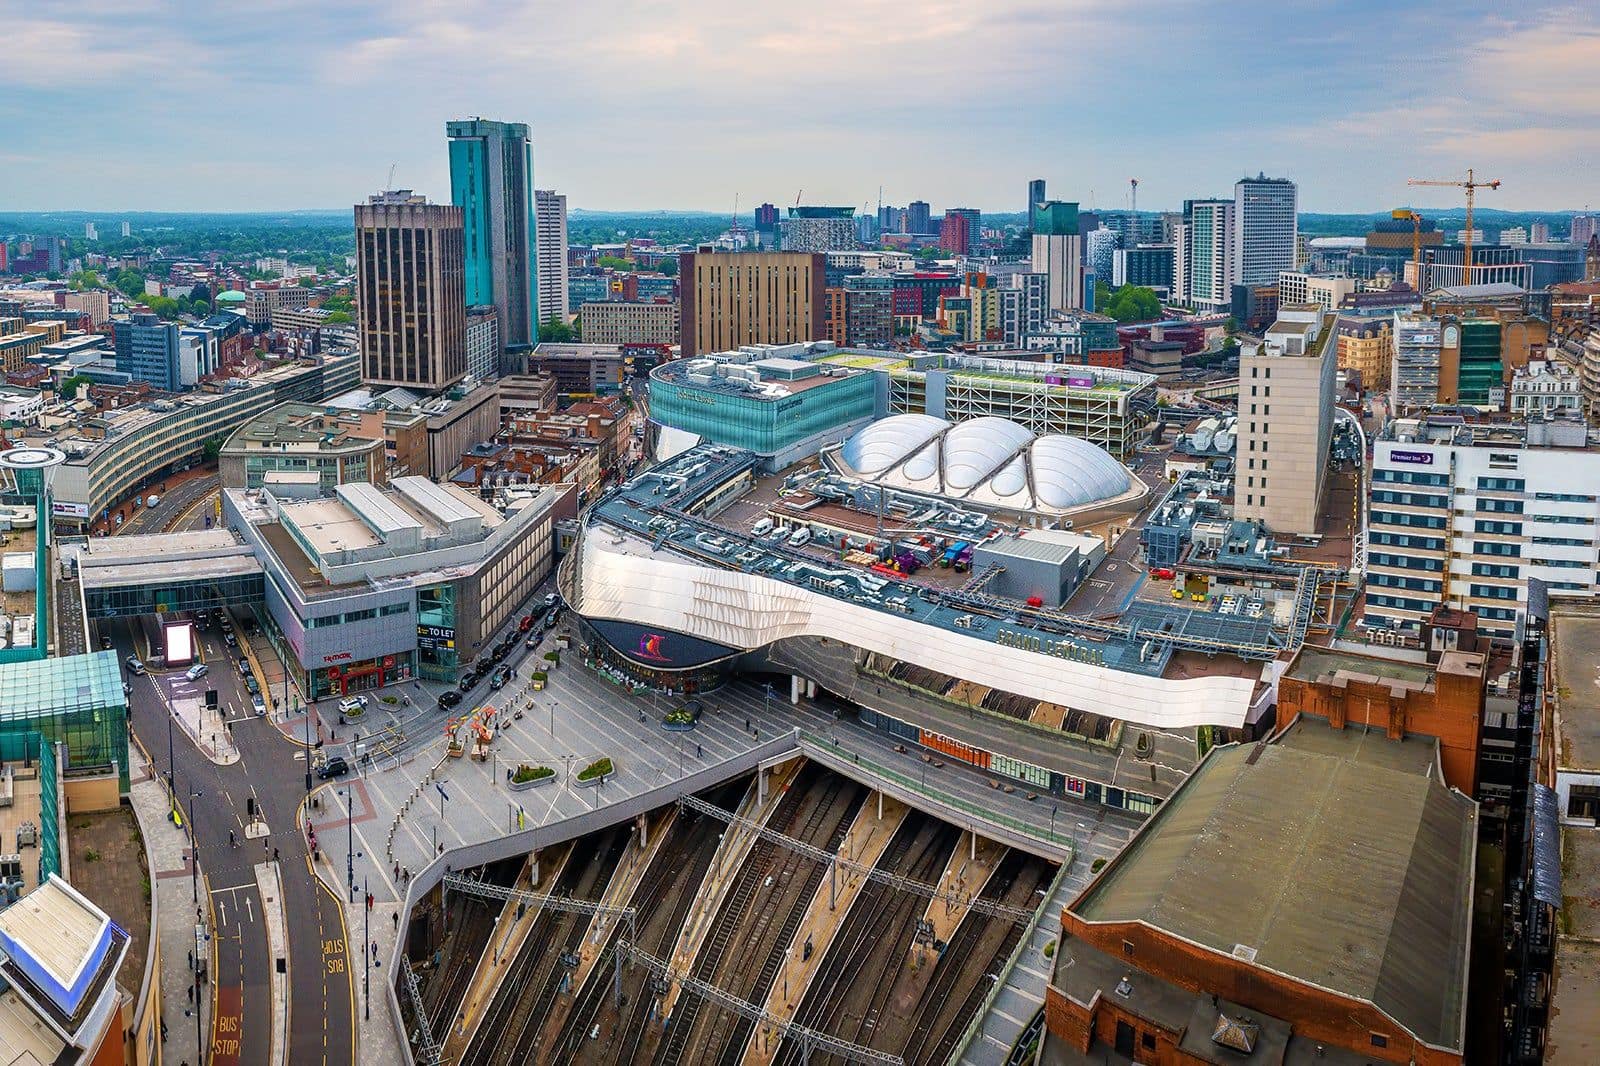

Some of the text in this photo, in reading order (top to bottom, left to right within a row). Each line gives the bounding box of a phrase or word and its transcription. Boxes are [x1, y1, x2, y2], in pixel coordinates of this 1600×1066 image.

[428, 627, 439, 636] TO
[440, 629, 455, 638] LET
[997, 628, 1105, 664] GRAND CENTRAL
[323, 939, 344, 955] STOP
[327, 959, 344, 974] BUS
[219, 1016, 238, 1032] BUS
[215, 1040, 238, 1055] STOP
